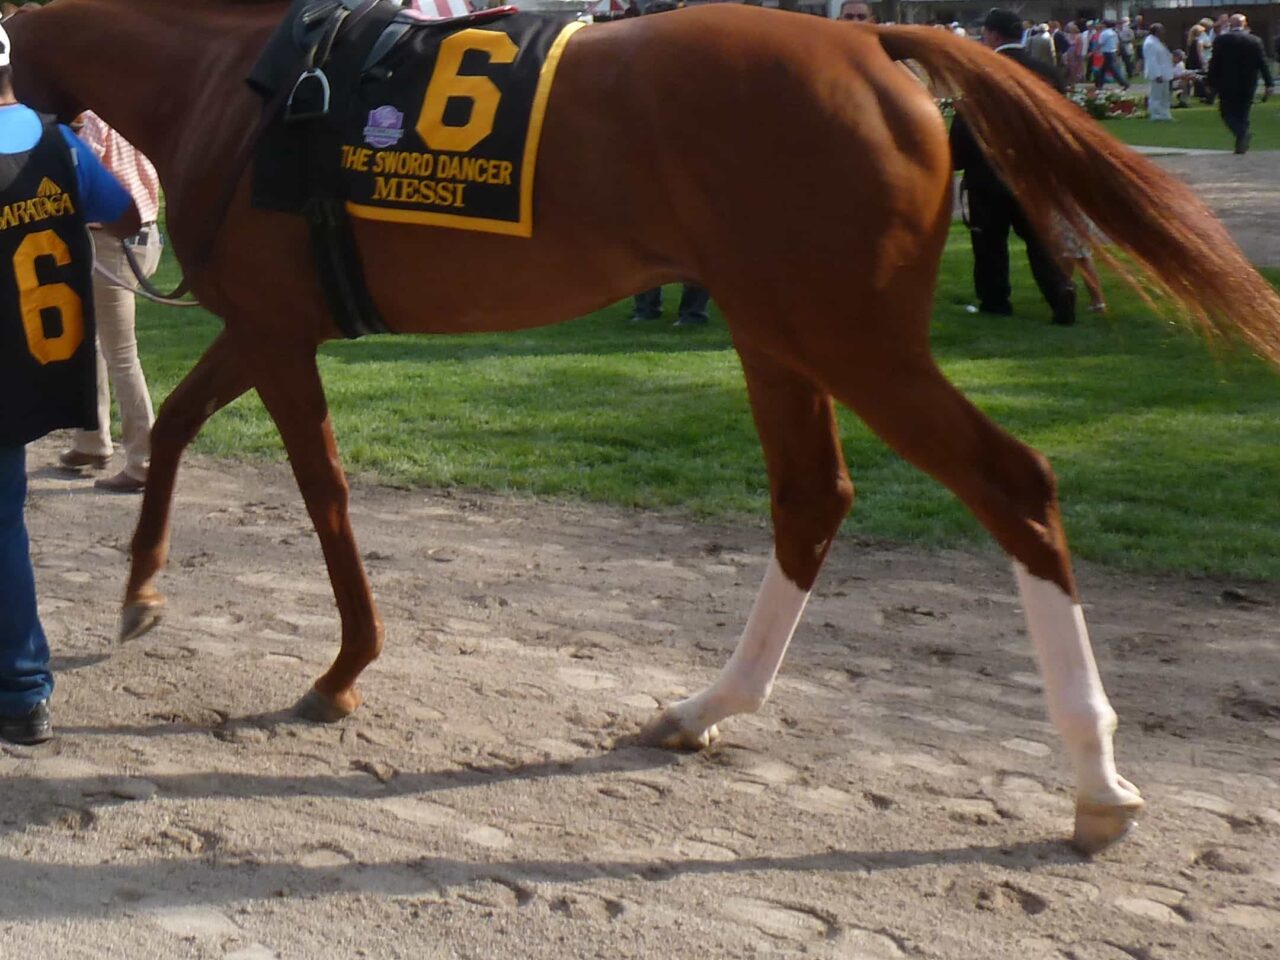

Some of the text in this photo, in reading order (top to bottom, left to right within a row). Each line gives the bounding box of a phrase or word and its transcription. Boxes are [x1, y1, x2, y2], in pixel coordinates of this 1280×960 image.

[415, 27, 519, 152] 6
[341, 145, 513, 185] THE SWORD DANCER
[372, 176, 467, 208] MESSI
[13, 229, 84, 365] 6
